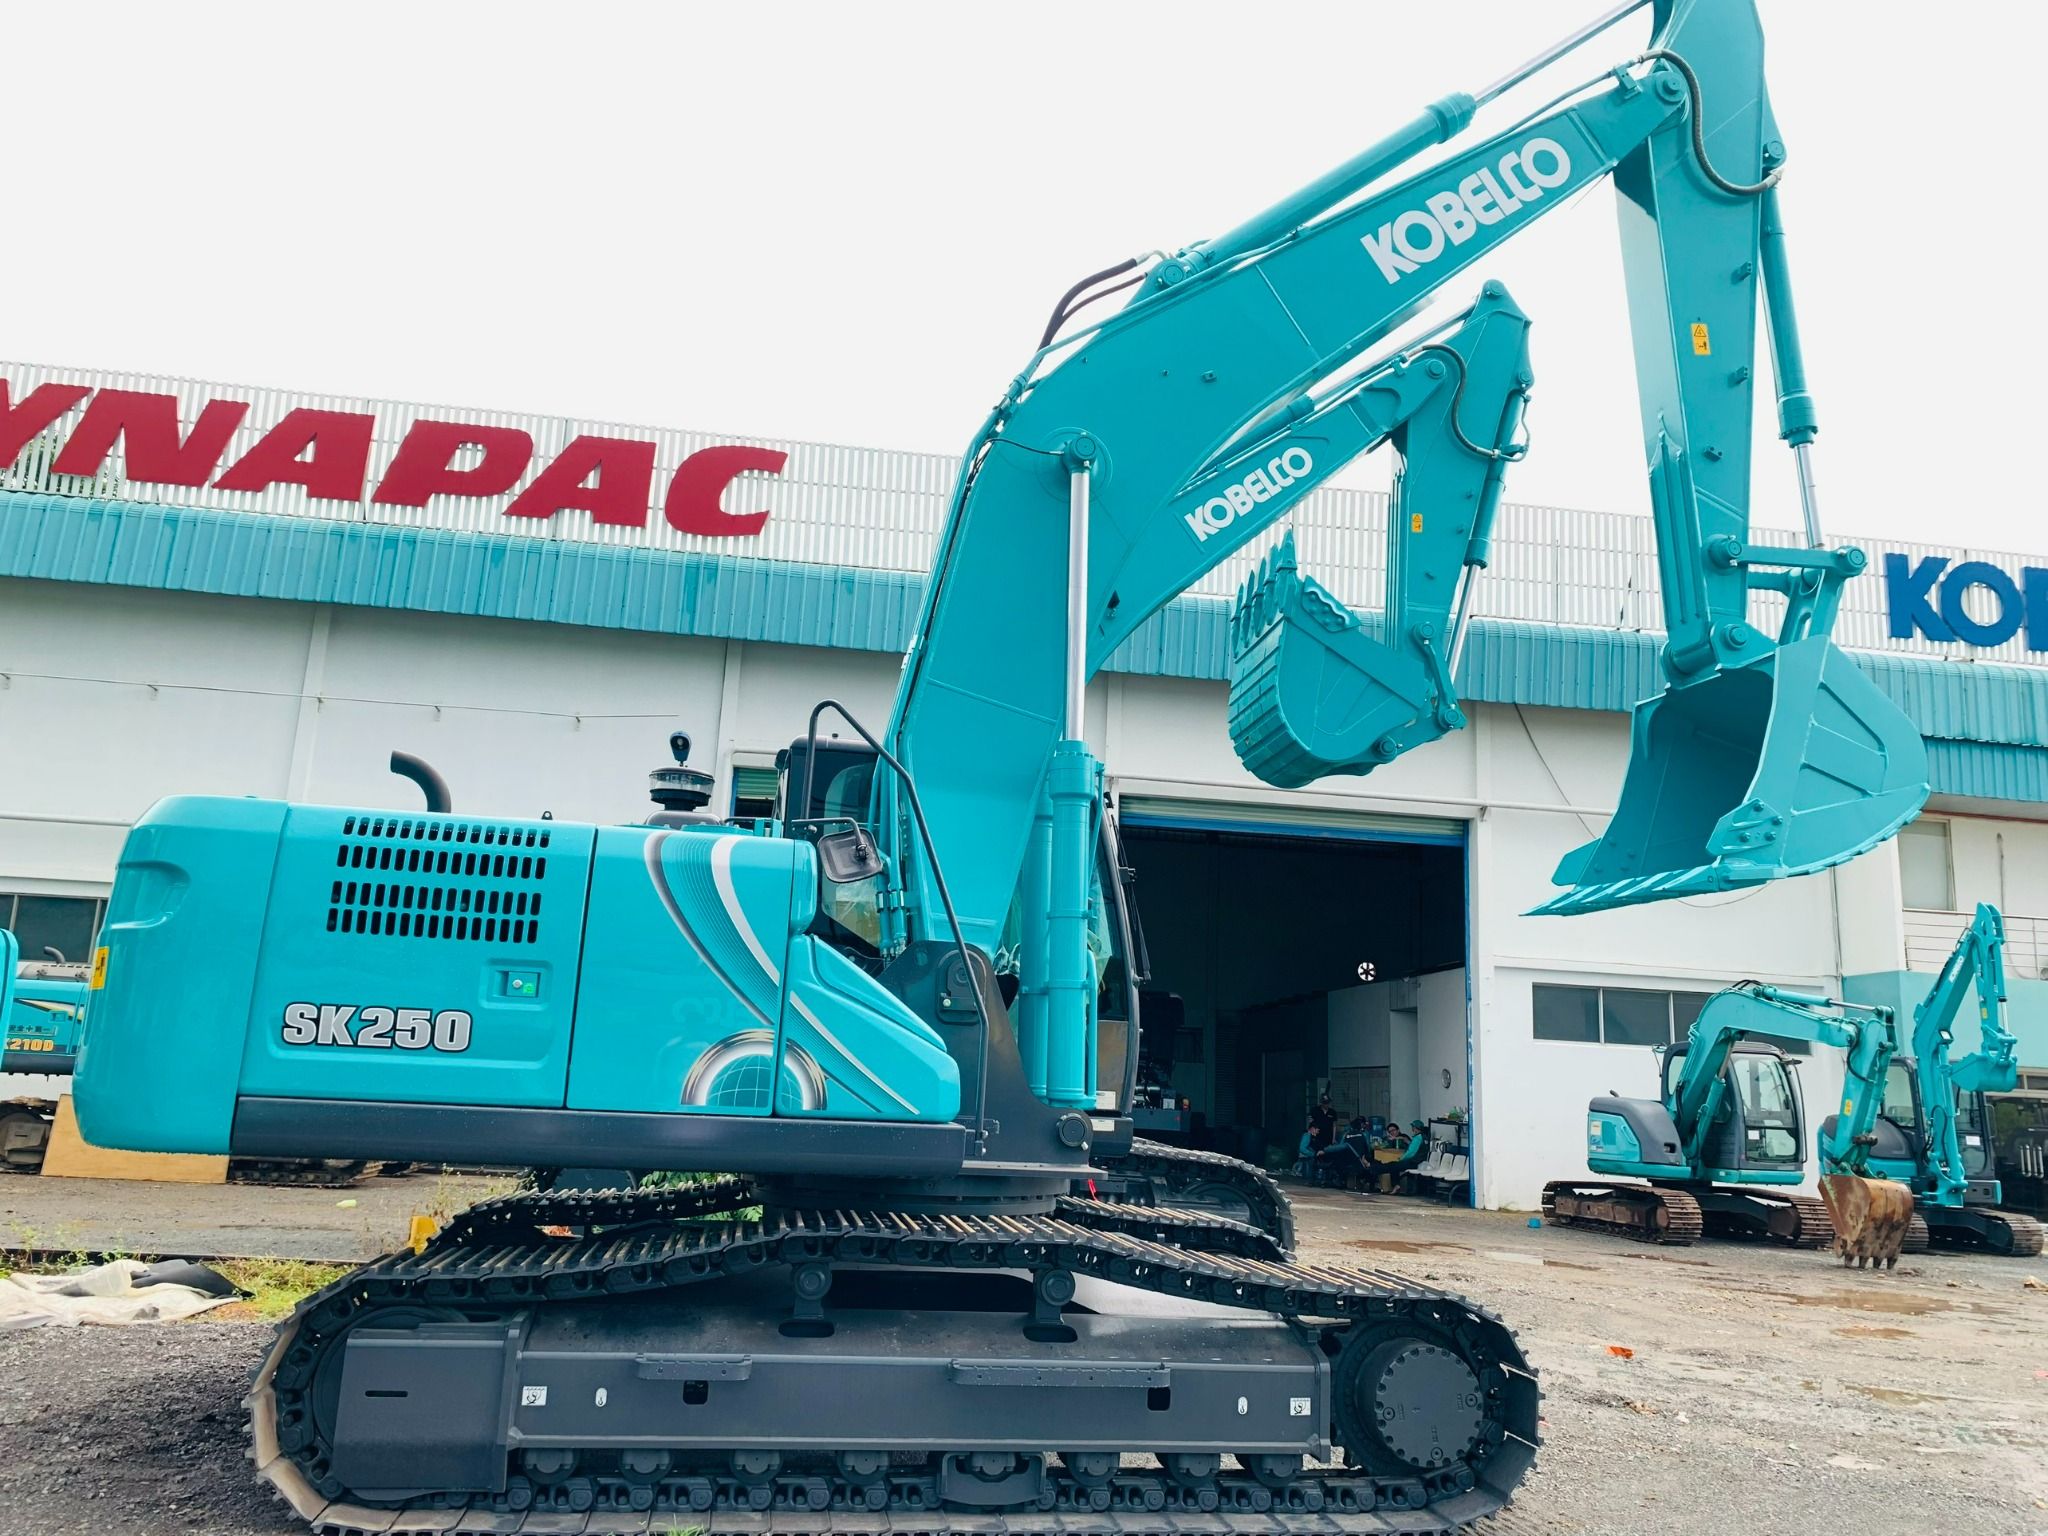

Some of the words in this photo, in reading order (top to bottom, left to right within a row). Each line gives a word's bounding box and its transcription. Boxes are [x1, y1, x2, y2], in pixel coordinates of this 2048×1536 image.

[1360, 137, 1571, 285] KOBELCO
[1184, 447, 1313, 543] KOBELCO
[281, 1002, 473, 1053] SK250
